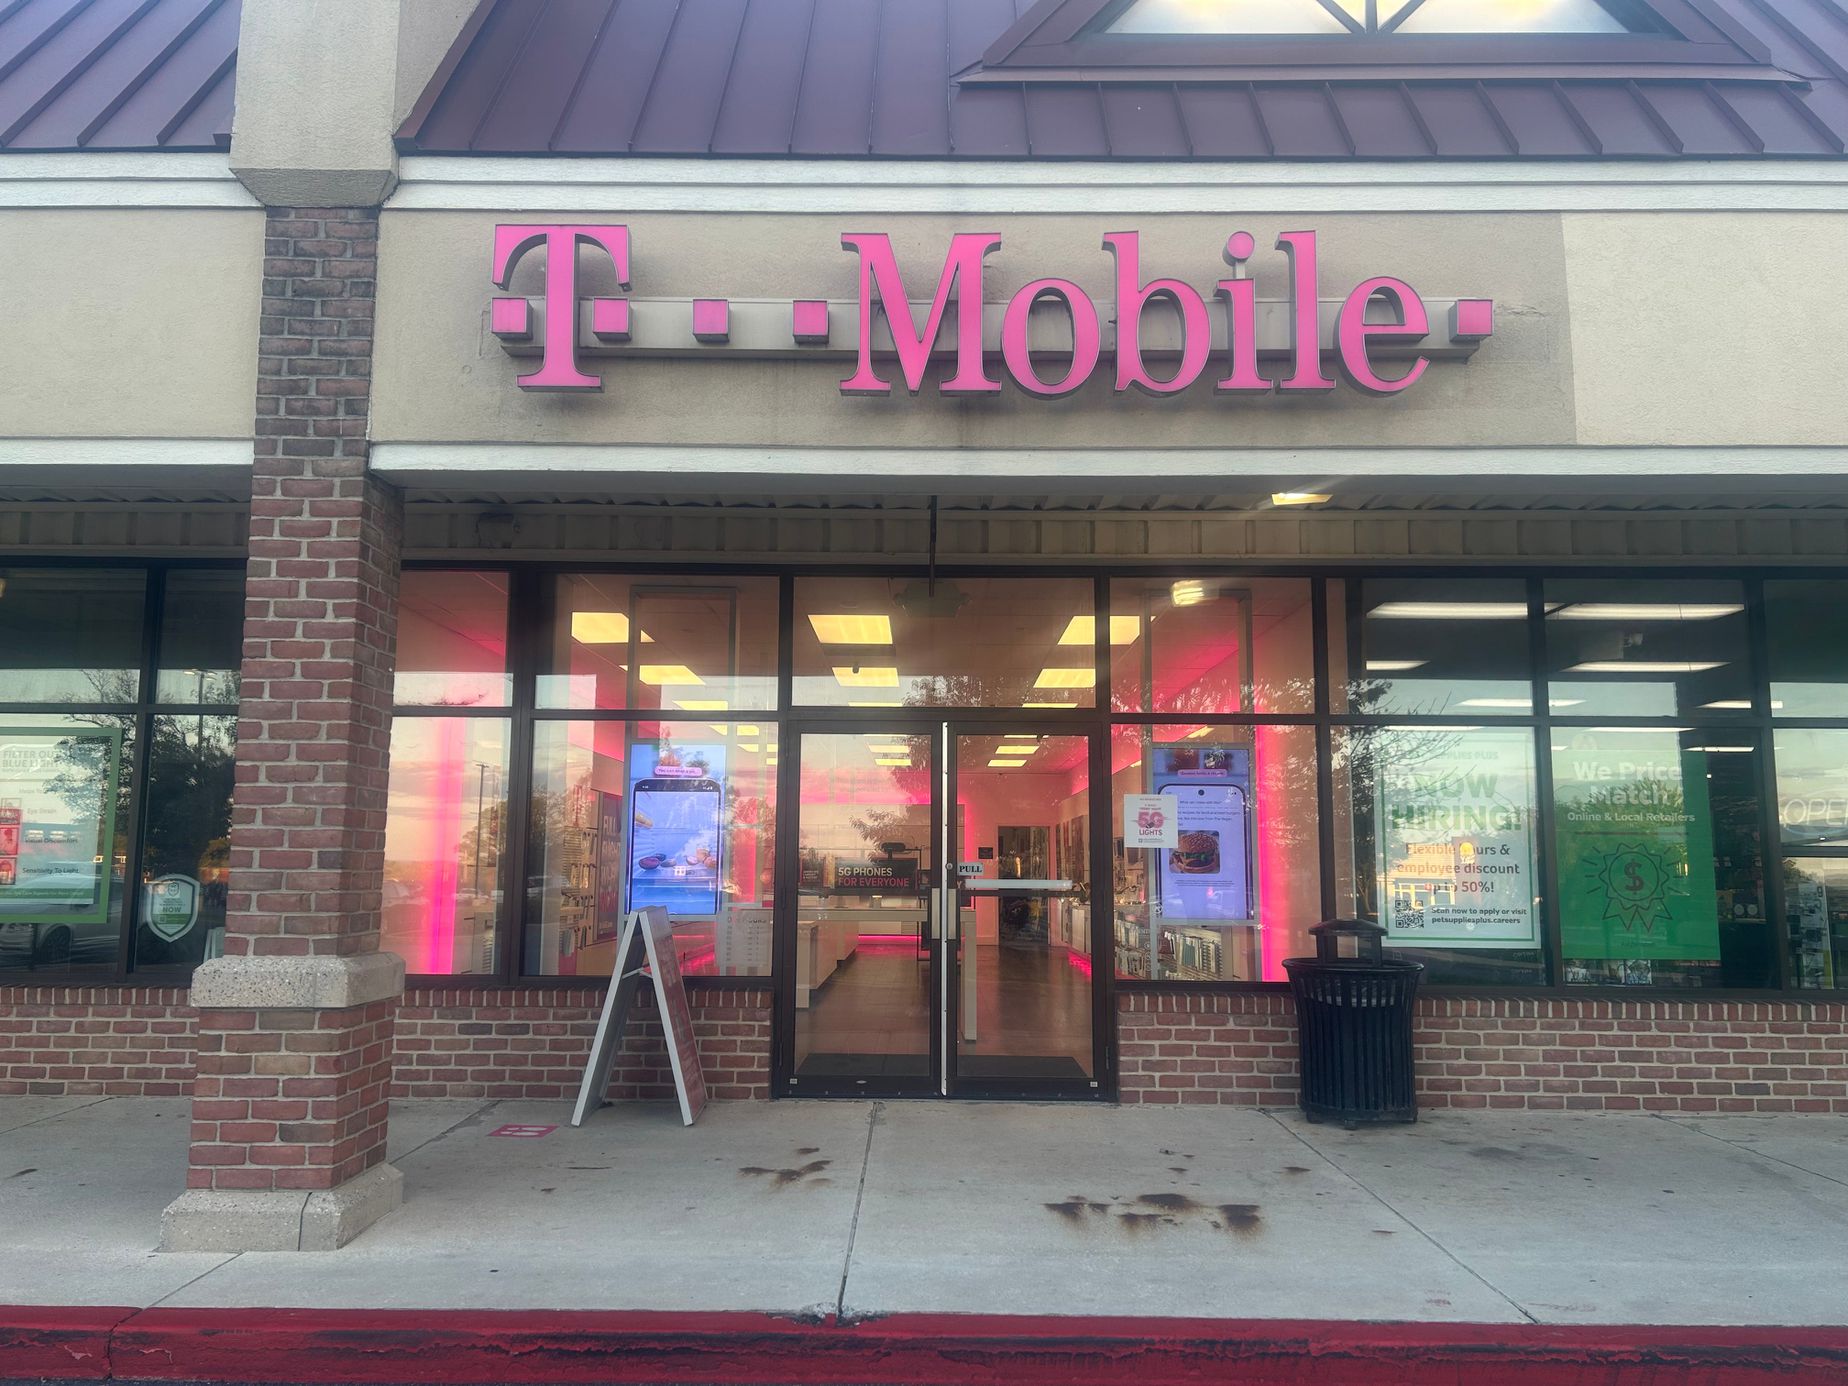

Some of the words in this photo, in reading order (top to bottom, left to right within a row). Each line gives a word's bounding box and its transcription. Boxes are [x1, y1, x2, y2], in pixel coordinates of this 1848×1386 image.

[1573, 761, 1612, 781] We
[1618, 761, 1682, 781] Price
[1567, 811, 1602, 822] Online
[1604, 812, 1614, 822] &
[1615, 812, 1643, 822] Local
[1646, 812, 1696, 823] Retailers
[1783, 797, 1848, 826] OPE
[1405, 842, 1456, 855] Flexible
[1499, 843, 1511, 856] &
[838, 867, 852, 877] 5G
[853, 867, 893, 877] PHONES
[959, 865, 983, 873] PULL
[1396, 861, 1461, 876] employee
[1464, 863, 1521, 874] discount
[838, 877, 858, 887] FOR
[859, 877, 910, 887] EVERYONE
[1461, 881, 1495, 893] 50%!
[1431, 907, 1450, 915] Scan
[1469, 907, 1478, 915] to
[1479, 907, 1500, 916] apply
